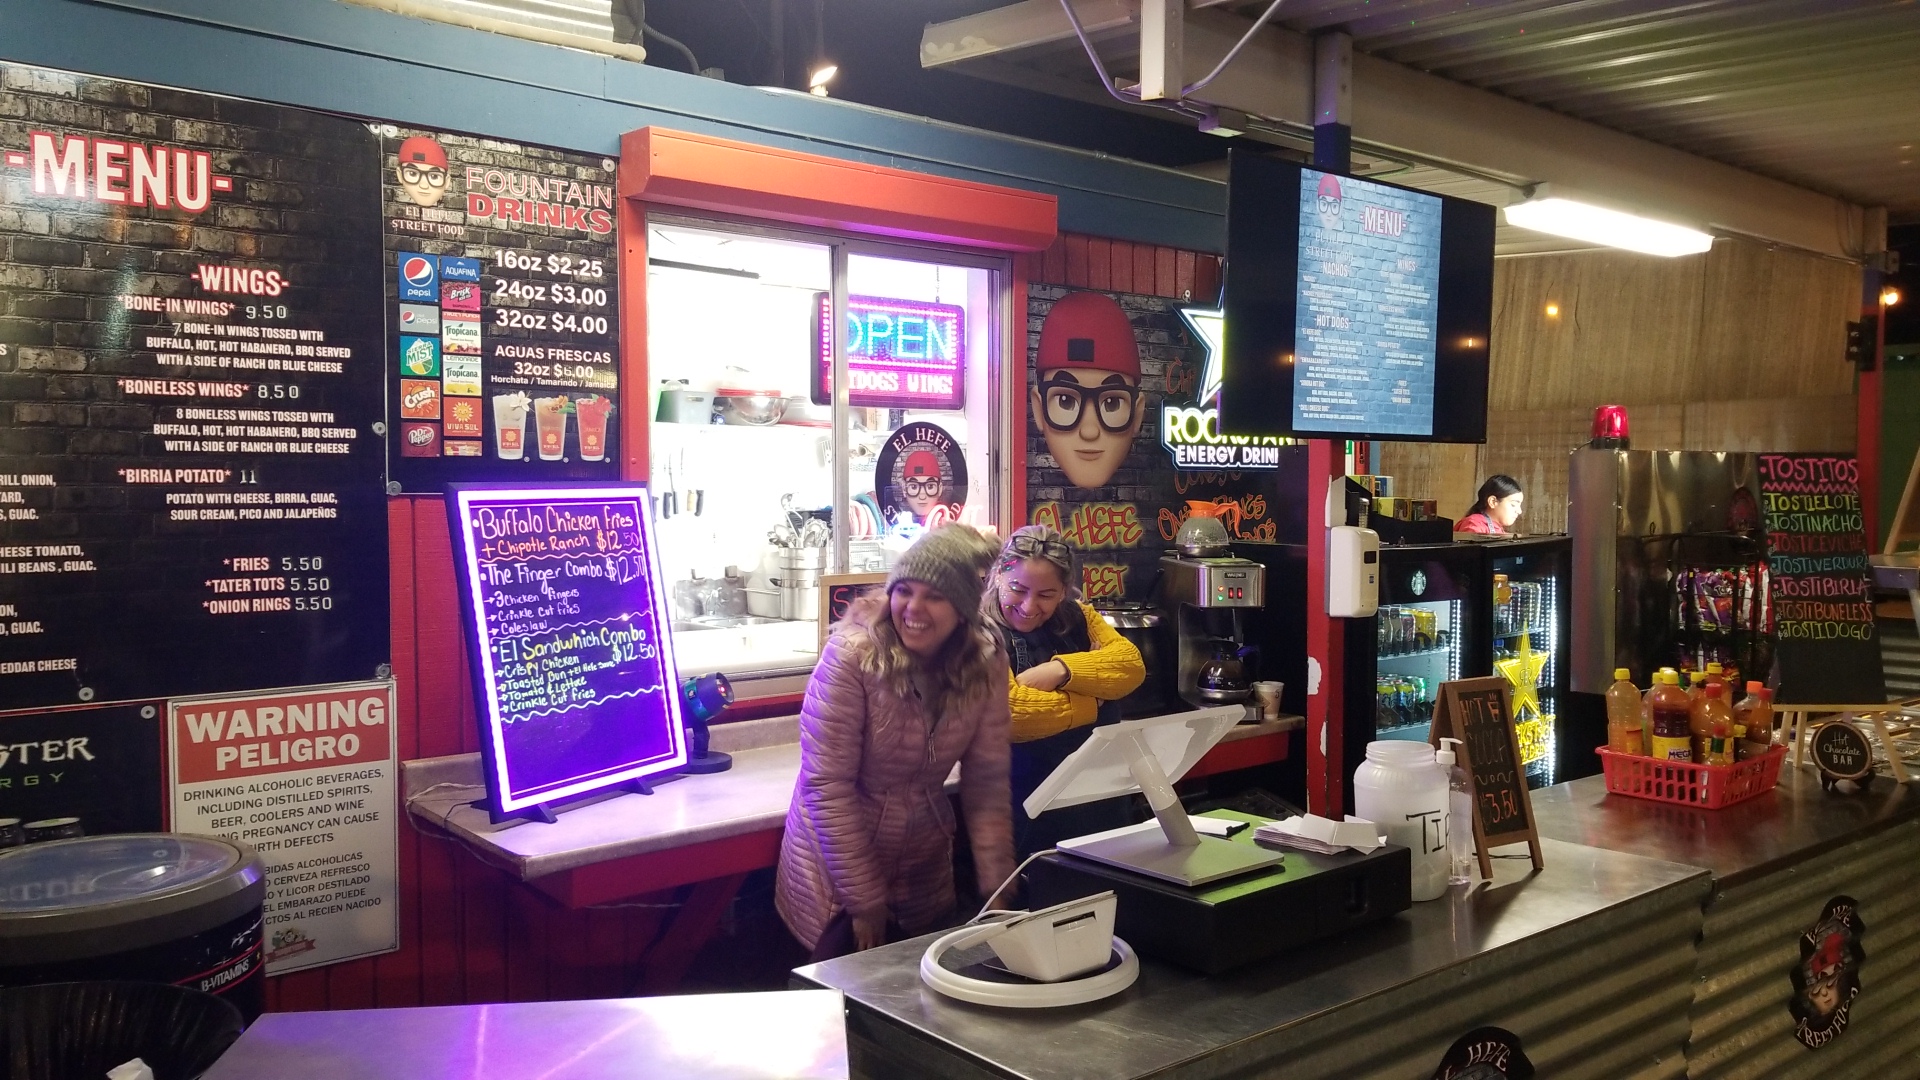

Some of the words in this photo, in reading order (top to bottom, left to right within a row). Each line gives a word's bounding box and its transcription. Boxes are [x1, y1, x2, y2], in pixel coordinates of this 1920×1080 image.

[466, 167, 612, 209] FOUNTAIN
[467, 192, 612, 234] DRINKS
[391, 219, 436, 232] STREET
[438, 224, 464, 235] FOOD
[445, 266, 476, 277] AQUAFINA
[495, 250, 542, 272] 16oz
[547, 254, 603, 278] $2.25
[407, 288, 431, 298] pepsi
[450, 287, 471, 299] Brisk
[495, 279, 546, 302] 24oz
[551, 284, 607, 307] $3.00
[246, 305, 288, 319] 9.50
[445, 324, 479, 337] Tropicana
[495, 309, 546, 330] 32oz
[551, 312, 608, 335] $4.00
[184, 323, 225, 335] BONE-IN
[227, 326, 260, 337] WINGS
[261, 328, 297, 340] TOSSED
[299, 330, 323, 341] WITH
[147, 337, 194, 350] BUFFALO,
[196, 340, 217, 352] HOT,
[220, 341, 239, 352] HOT
[240, 342, 294, 356] HABANERO,
[296, 345, 314, 357] BBQ
[316, 346, 351, 358] SERVED
[407, 347, 432, 365] MIST
[495, 345, 545, 360] AGUAS
[548, 348, 611, 363] FRESCAS
[157, 354, 184, 365] WITH
[194, 356, 218, 367] SIDE
[233, 358, 265, 369] RANCH
[283, 360, 306, 371] BLUE
[308, 361, 342, 373] CHEESE
[445, 366, 479, 378] Tropicana
[514, 362, 550, 376] 32oz
[491, 375, 528, 385] Horchata
[537, 378, 578, 387] Tamarindo
[585, 381, 615, 389] Jamaica
[258, 385, 299, 400] 8.50
[404, 385, 435, 409] Crush
[892, 432, 911, 453] EL
[916, 428, 951, 453] HEFE
[1178, 445, 1235, 464] ENERGY
[239, 470, 257, 484] 11
[1760, 456, 1859, 483] TOSTITOS
[21, 474, 56, 487] ONION,
[166, 494, 204, 504] POTATO
[206, 494, 231, 504] WITH
[233, 494, 272, 504] CHEESE,
[275, 493, 309, 504] BIRRIA,
[311, 493, 338, 504] GUAC,
[1763, 493, 1860, 512] TOSTIELOTE
[9, 509, 39, 520] GUAC.
[170, 509, 198, 520] SOUR
[200, 509, 238, 521] CREAM,
[239, 509, 261, 519] PICO
[263, 509, 283, 519] AND
[284, 506, 337, 519] JALAPEÑOS
[479, 507, 543, 539] Buffalo
[546, 506, 600, 532] Chicken
[1072, 506, 1142, 545] HEFE
[36, 545, 84, 558] TOMATO,
[497, 537, 547, 557] Chipotle
[549, 534, 590, 551] Ranch
[18, 561, 55, 573] BEANS
[63, 560, 97, 572] GUAC.
[281, 557, 322, 571] 5.50
[253, 578, 285, 592] TOTS
[290, 578, 330, 591] 5.50
[482, 564, 514, 585] The
[514, 563, 561, 594] Finger
[565, 559, 602, 577] Combo
[253, 597, 291, 612] RINGS
[295, 597, 332, 611] 5.50
[498, 611, 534, 622] Crinkle
[600, 623, 646, 646] Combo
[500, 639, 517, 663] El
[522, 628, 600, 661] Sandwhich
[612, 642, 655, 665] $12.50
[37, 659, 77, 671] CHEESE
[503, 664, 538, 679] Crispy
[542, 655, 580, 671] Chicken
[506, 674, 544, 690] Toasted
[508, 687, 544, 701] Tomato
[509, 698, 548, 712] Crinkle
[184, 697, 385, 744] WARNING
[216, 734, 360, 771] PELIGRO
[1833, 755, 1852, 765] BAR
[183, 786, 244, 802] DRINKING
[248, 777, 313, 794] ALCOHOLIC
[316, 769, 384, 786] BEVERAGES,
[198, 798, 263, 815] INCLUDING
[267, 791, 324, 806] DISTILLED
[327, 785, 373, 799] SPIRITS,
[211, 816, 246, 829] BEER,
[249, 807, 304, 824] COOLERS
[307, 804, 332, 816] AND
[335, 800, 364, 812] WINE
[243, 821, 315, 839] PREGNANCY
[317, 818, 341, 829] CAN
[344, 812, 379, 825] CAUSE
[284, 833, 334, 848] DEFECTS
[297, 852, 363, 871] ALCOHOLICAS
[274, 872, 318, 886] CERVEZA
[321, 863, 370, 877] REFRESCO
[286, 884, 315, 896] LICOR
[318, 875, 370, 891] DESTILADO
[278, 894, 332, 910] EMBARAZO
[335, 888, 366, 900] PUEDE
[309, 904, 343, 917] RECIEN
[345, 898, 381, 911] NACIDO
[201, 959, 249, 992] B-VITAMINS
